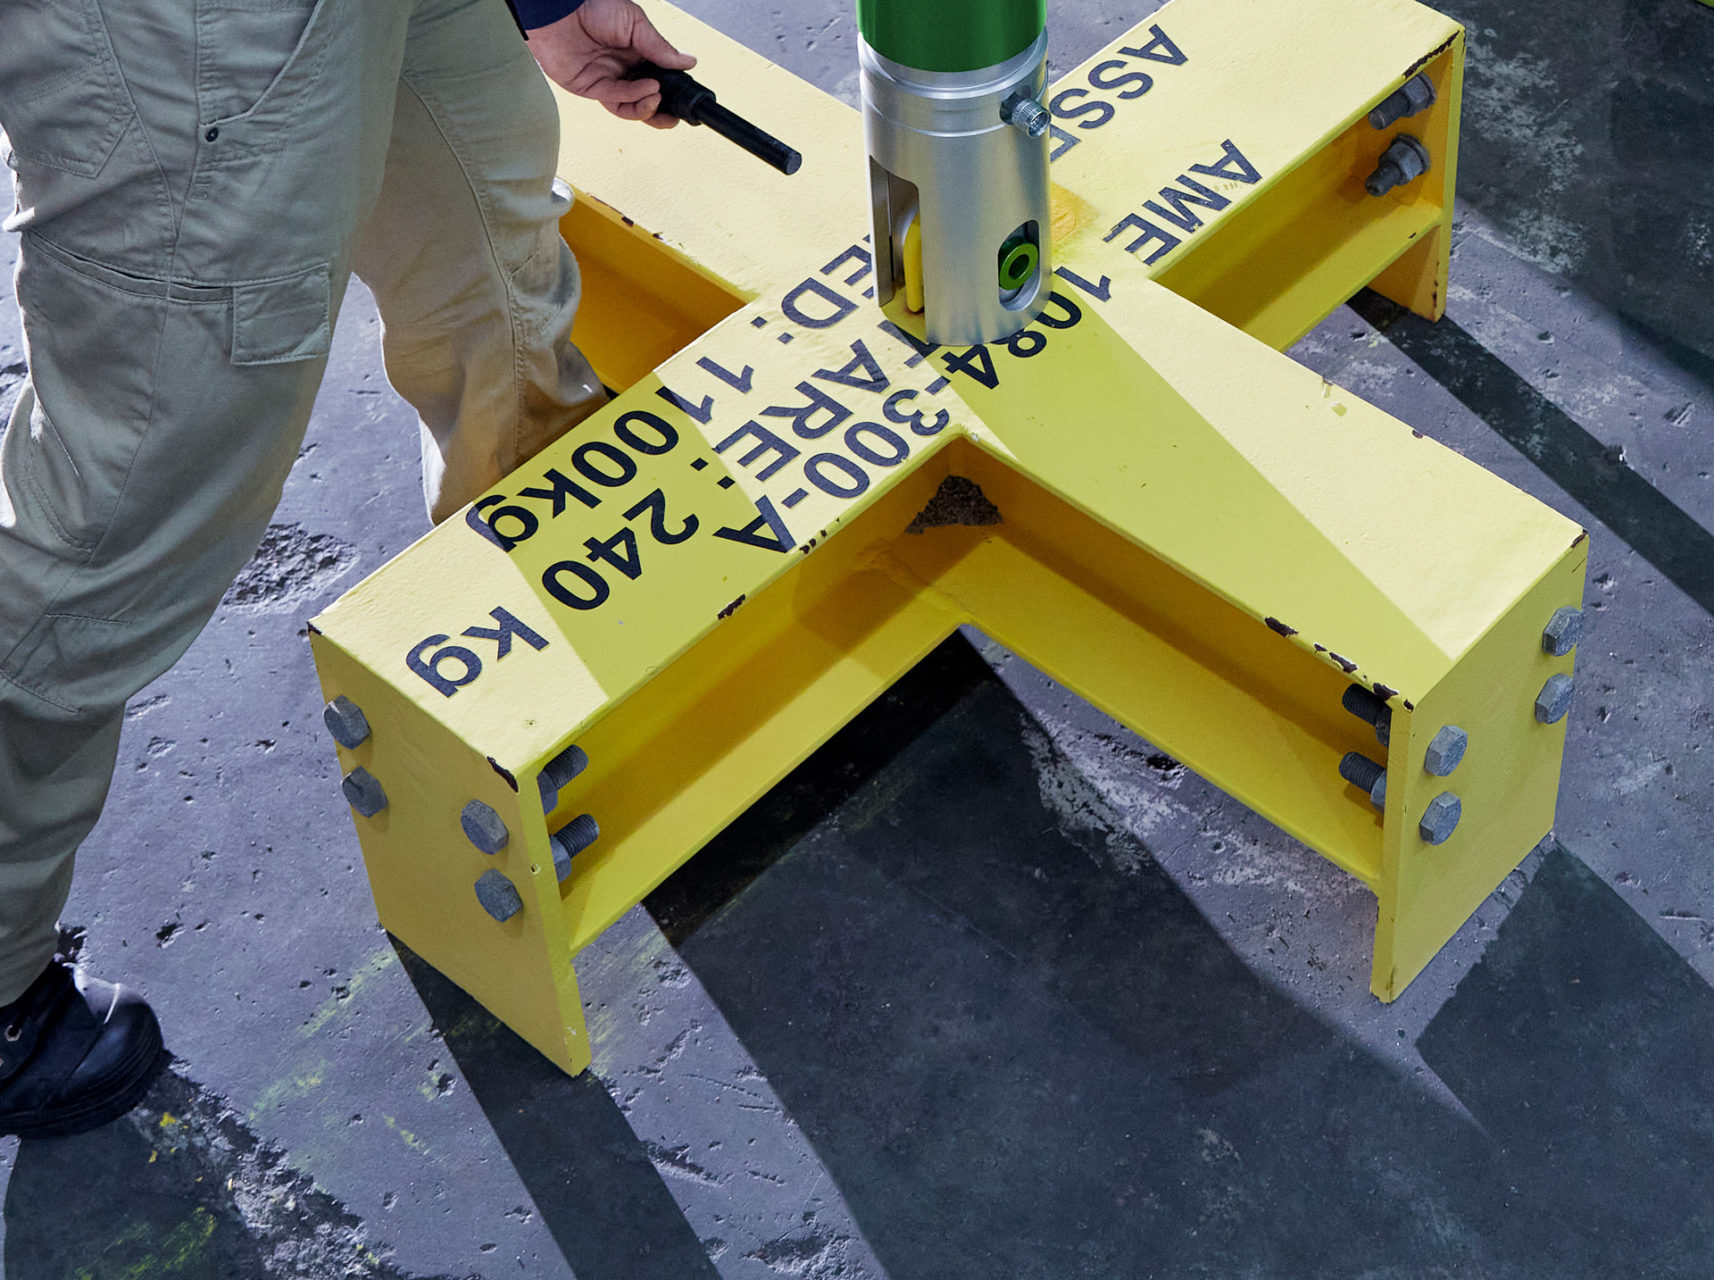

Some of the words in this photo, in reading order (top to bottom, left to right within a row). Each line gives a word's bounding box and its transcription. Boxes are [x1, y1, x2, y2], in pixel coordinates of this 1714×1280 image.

[1102, 138, 1263, 267] AME
[689, 319, 943, 490] TARE:
[711, 265, 1112, 554] 1084-300-A
[541, 487, 700, 611] 240
[405, 605, 550, 700] kg
